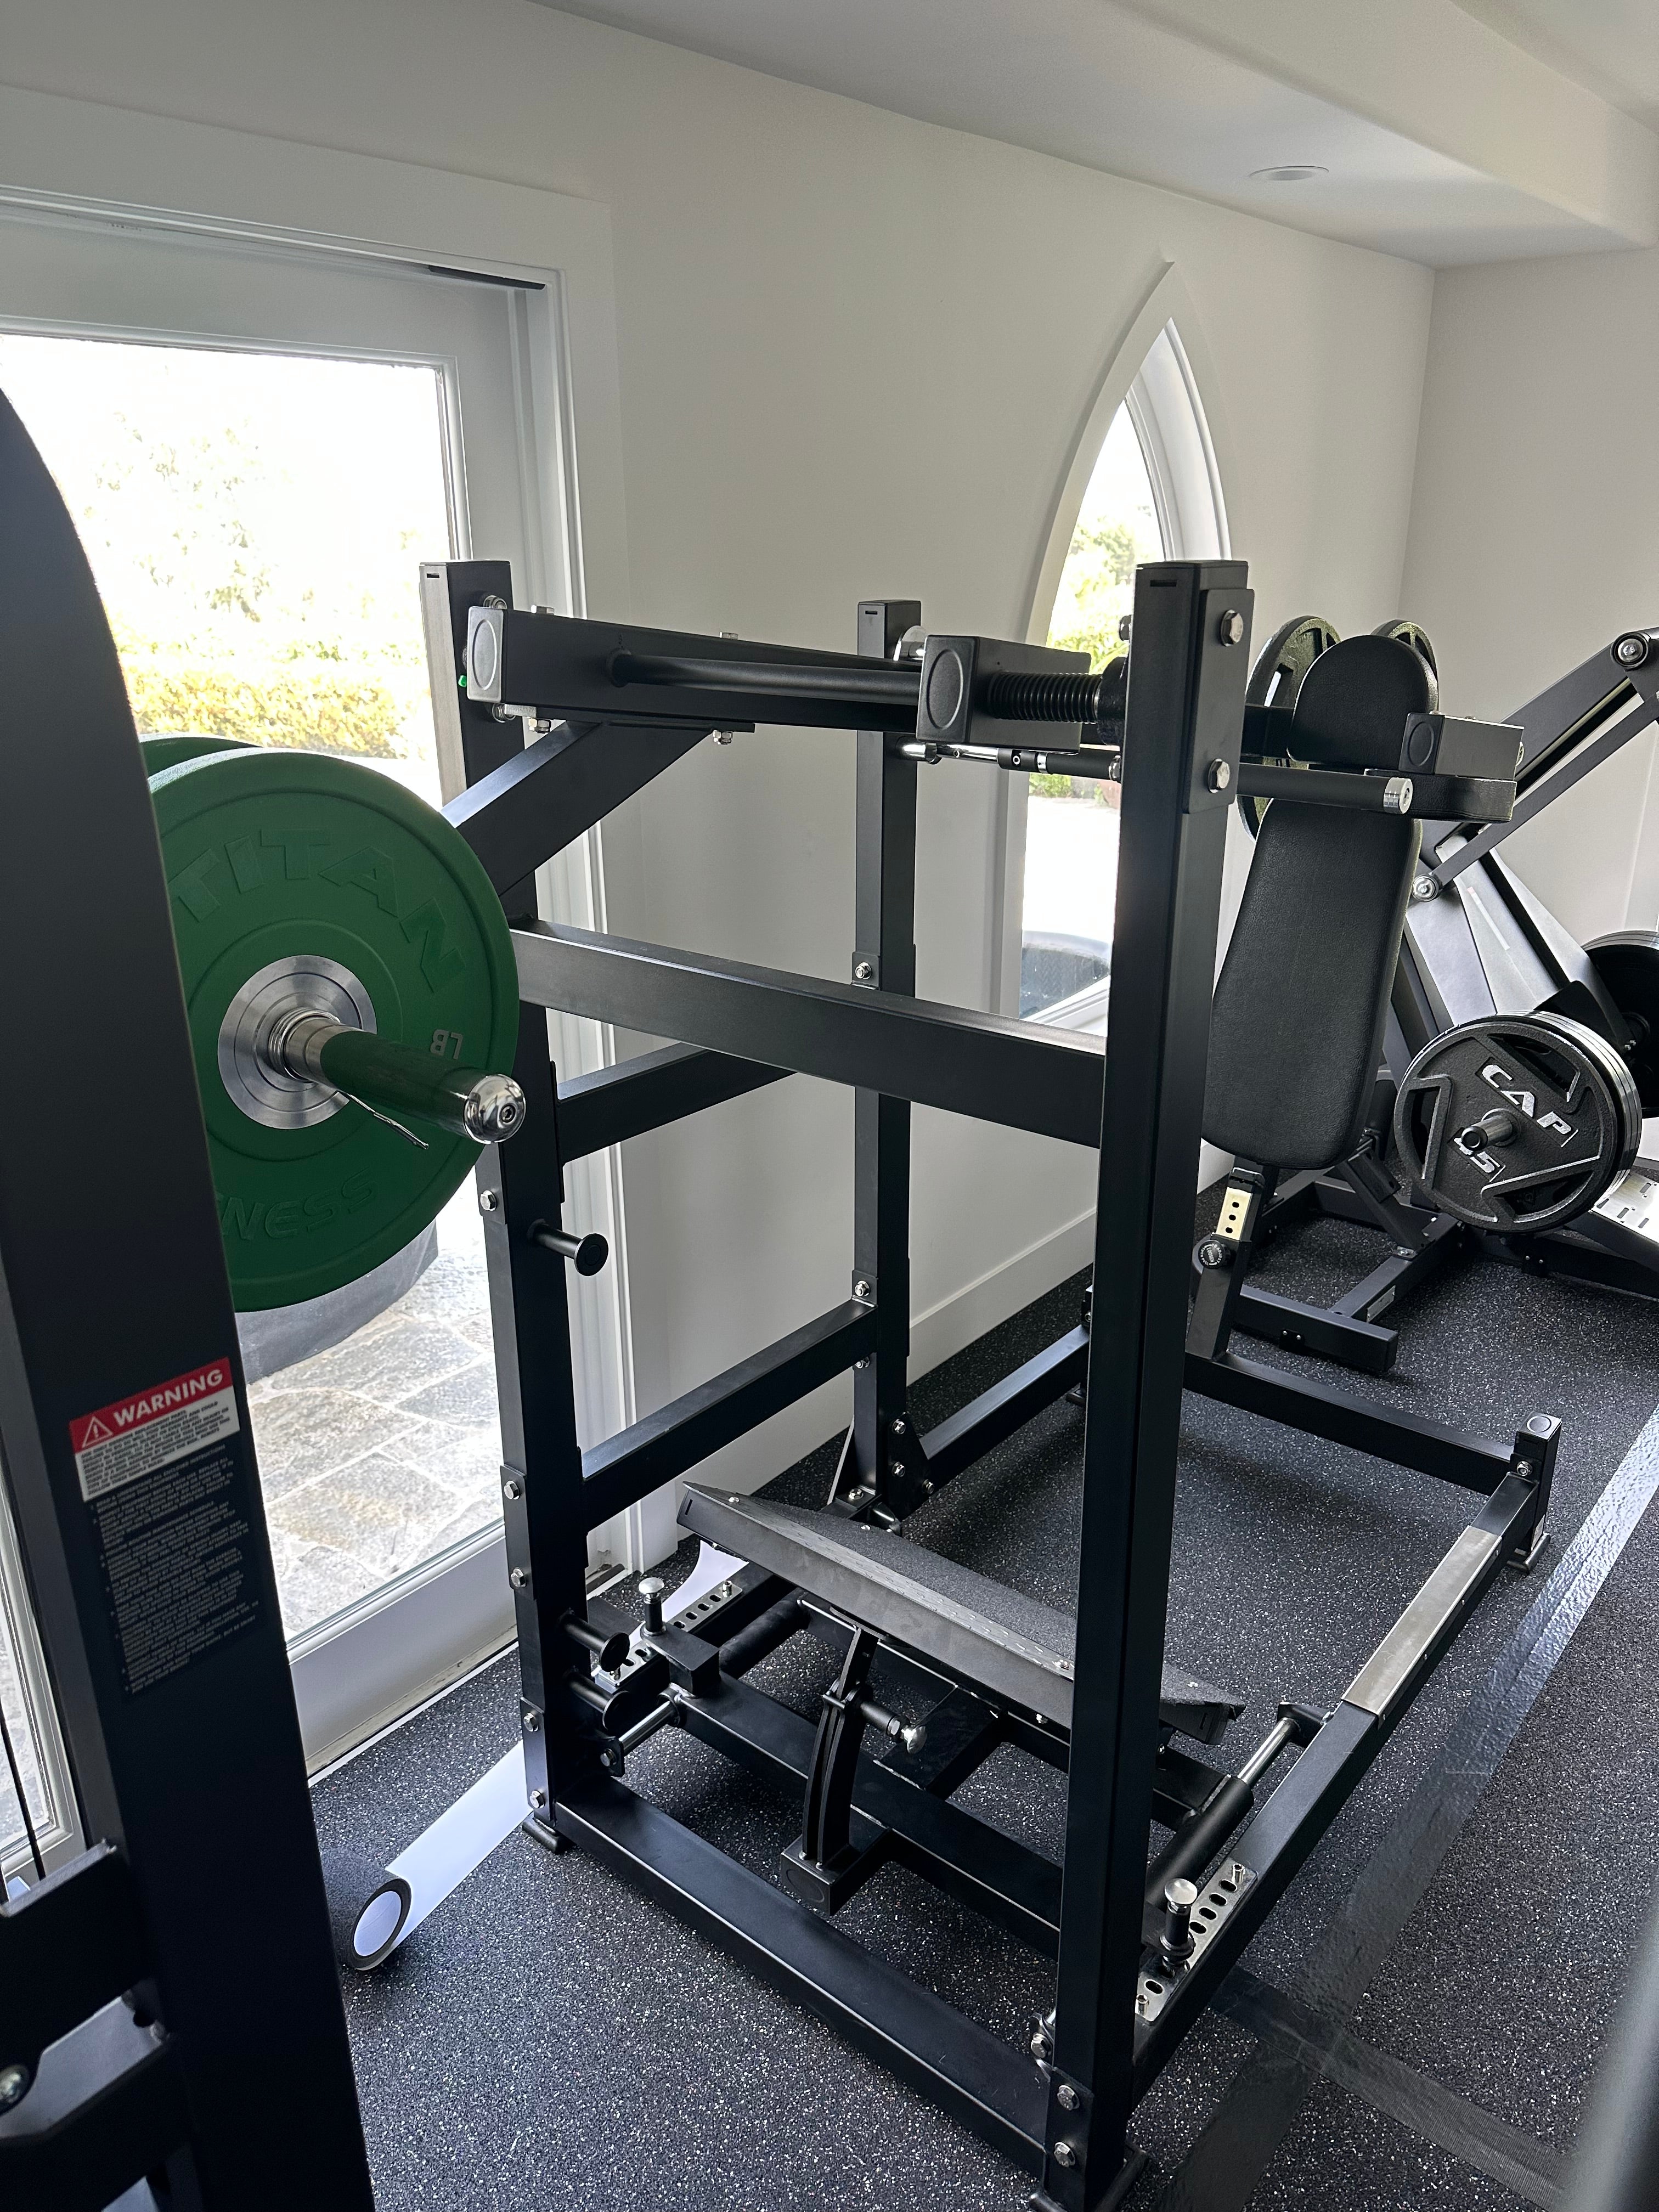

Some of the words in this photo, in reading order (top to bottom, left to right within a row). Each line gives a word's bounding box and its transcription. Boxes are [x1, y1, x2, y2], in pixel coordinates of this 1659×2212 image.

[166, 828, 466, 994] TITAN
[1482, 1064, 1572, 1135] CAP
[216, 1166, 377, 1241] NESS
[113, 1369, 223, 1426] WARNING
